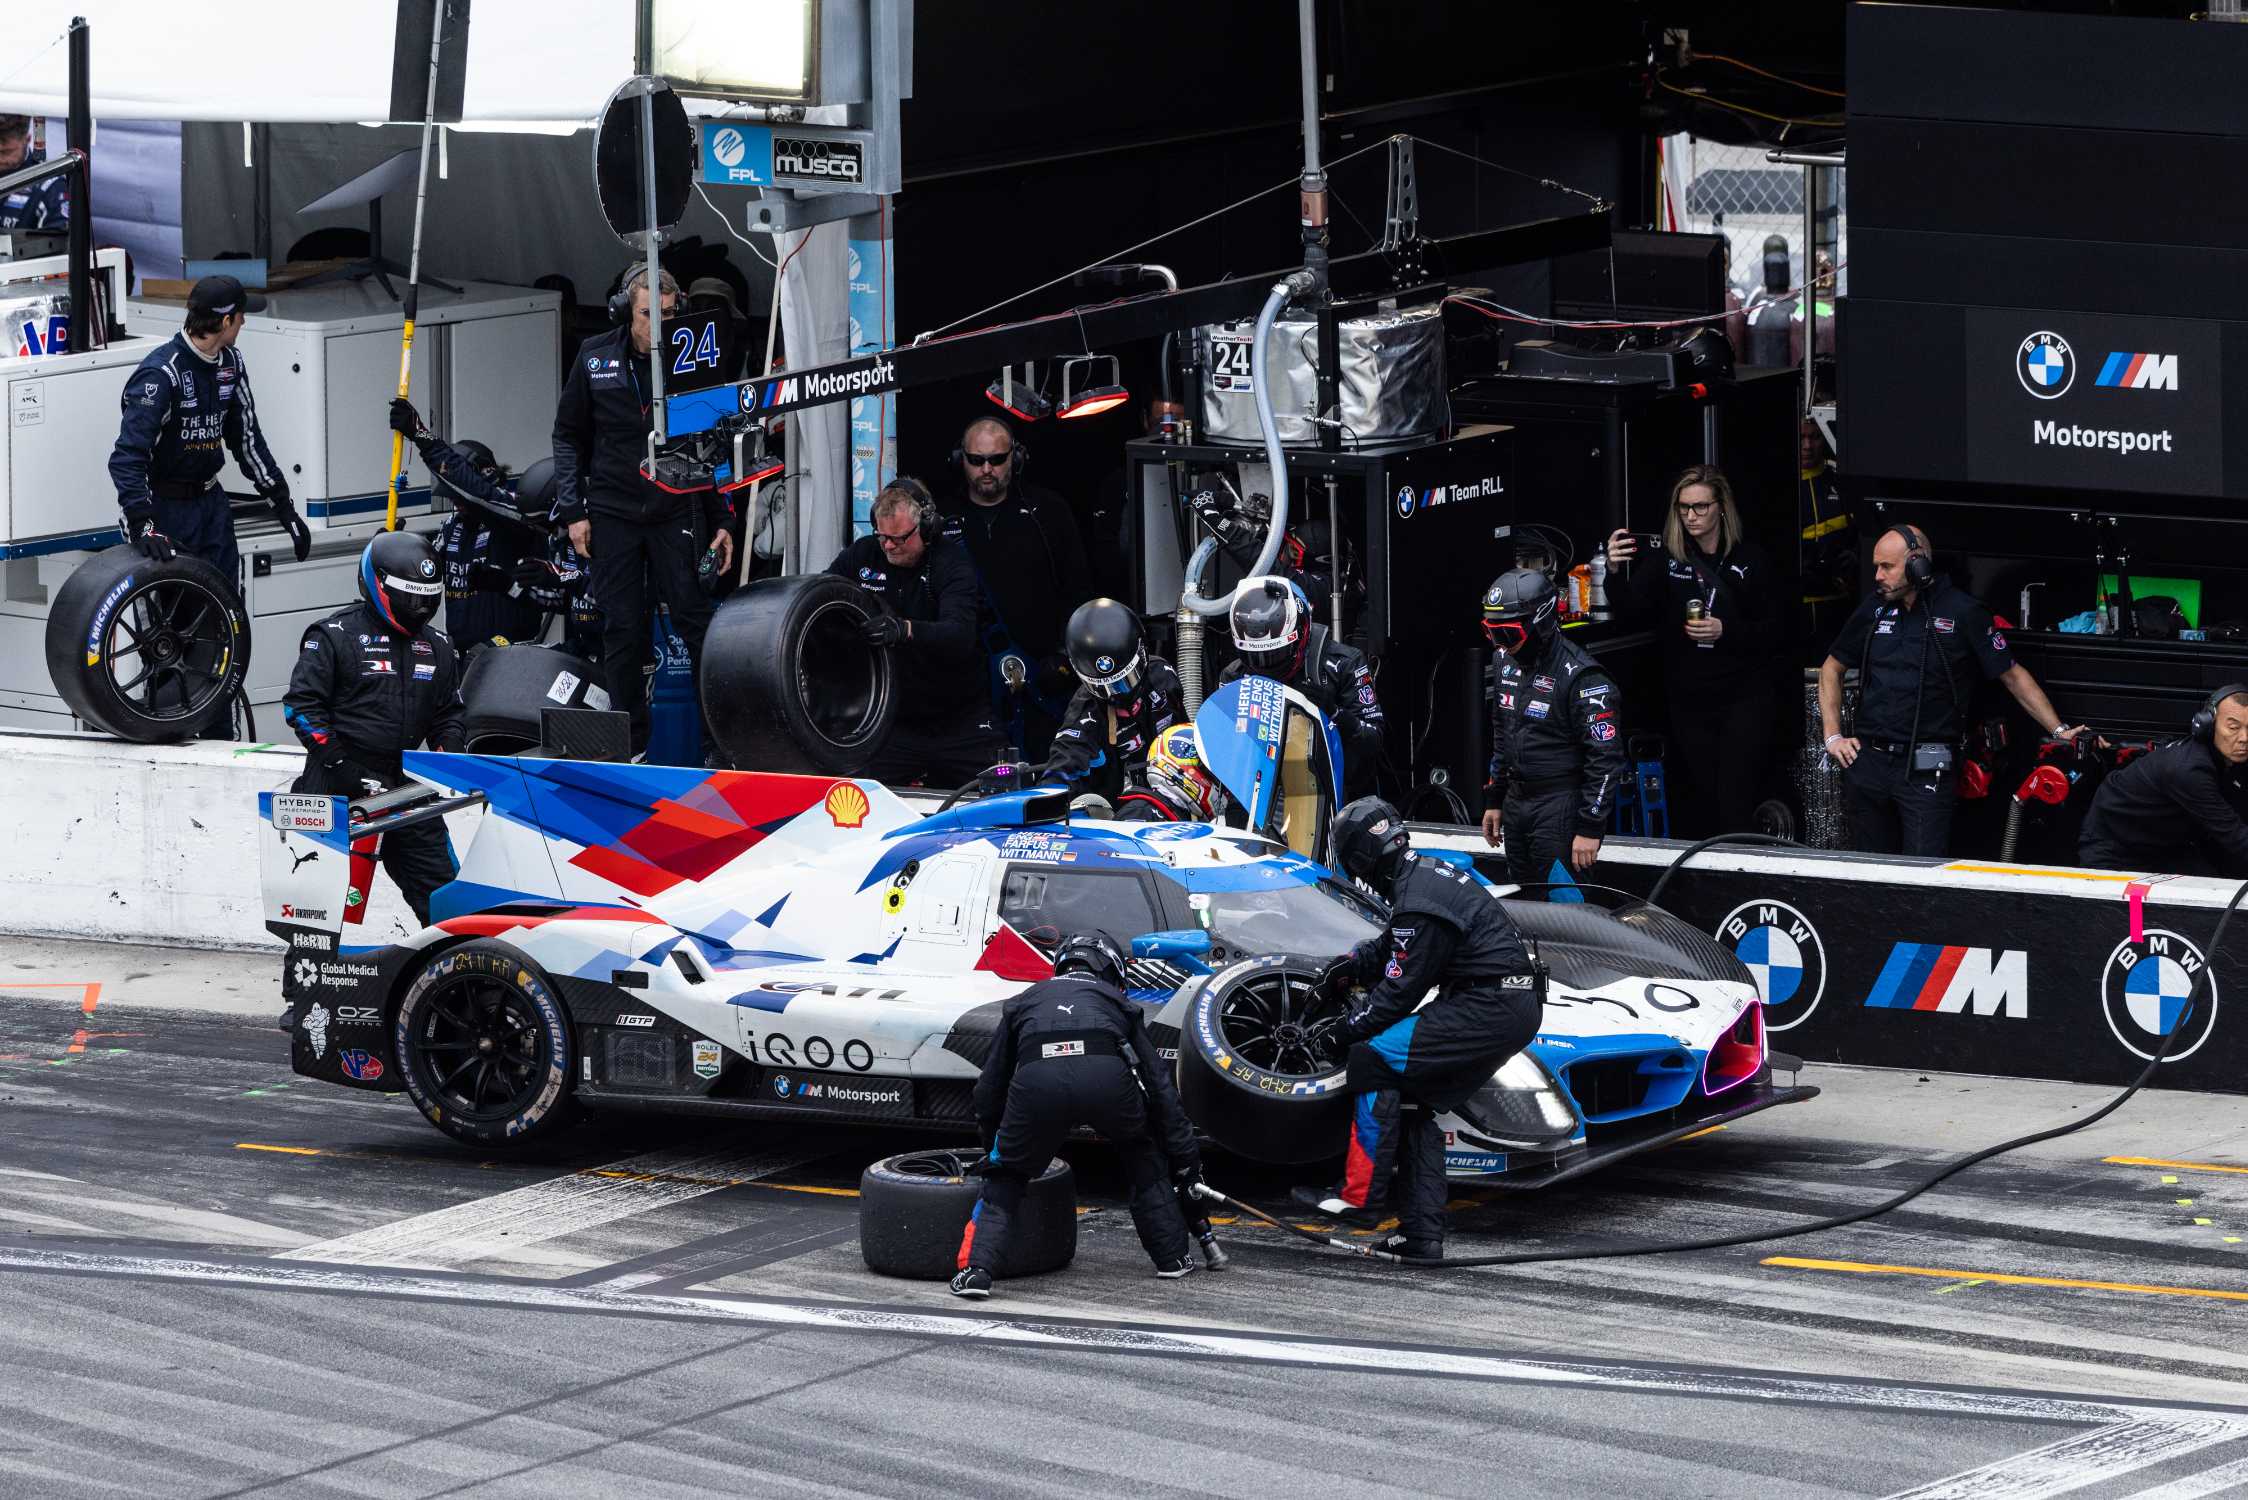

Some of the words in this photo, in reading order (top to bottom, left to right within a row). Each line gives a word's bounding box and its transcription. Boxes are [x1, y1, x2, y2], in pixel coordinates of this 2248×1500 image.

[729, 169, 762, 182] FPL
[672, 322, 720, 375] 24
[2024, 334, 2067, 354] BMW
[1216, 342, 1250, 375] 24
[804, 361, 895, 400] Motorsport
[2033, 420, 2173, 455] Motorsport
[1449, 484, 1480, 502] Team
[1481, 475, 1504, 496] RLL
[92, 579, 131, 640] MICHELIN
[1249, 641, 1282, 649] Motorsport
[1237, 676, 1252, 716] HERTA
[1251, 679, 1264, 703] ENG
[1260, 680, 1274, 725] FARFUS
[1268, 683, 1284, 742] WITTMANN
[280, 798, 326, 808] HYBRID
[295, 817, 326, 827] BOSCH
[1001, 848, 1061, 861] WITTMANN
[1004, 840, 1050, 850] FARFUS
[1727, 906, 1811, 944] BMW
[2117, 936, 2202, 974] BMW
[321, 963, 346, 974] Global
[347, 965, 379, 977] Medical
[322, 975, 358, 988] Response
[537, 994, 563, 1063] MICHELIN
[628, 1017, 654, 1025] GTP
[1199, 993, 1217, 1049] MICHELIN
[747, 1030, 874, 1072] iQOO
[1232, 1066, 1256, 1082] RF
[827, 1086, 901, 1104] Motorsport
[1444, 1156, 1498, 1167] ICHELIN
